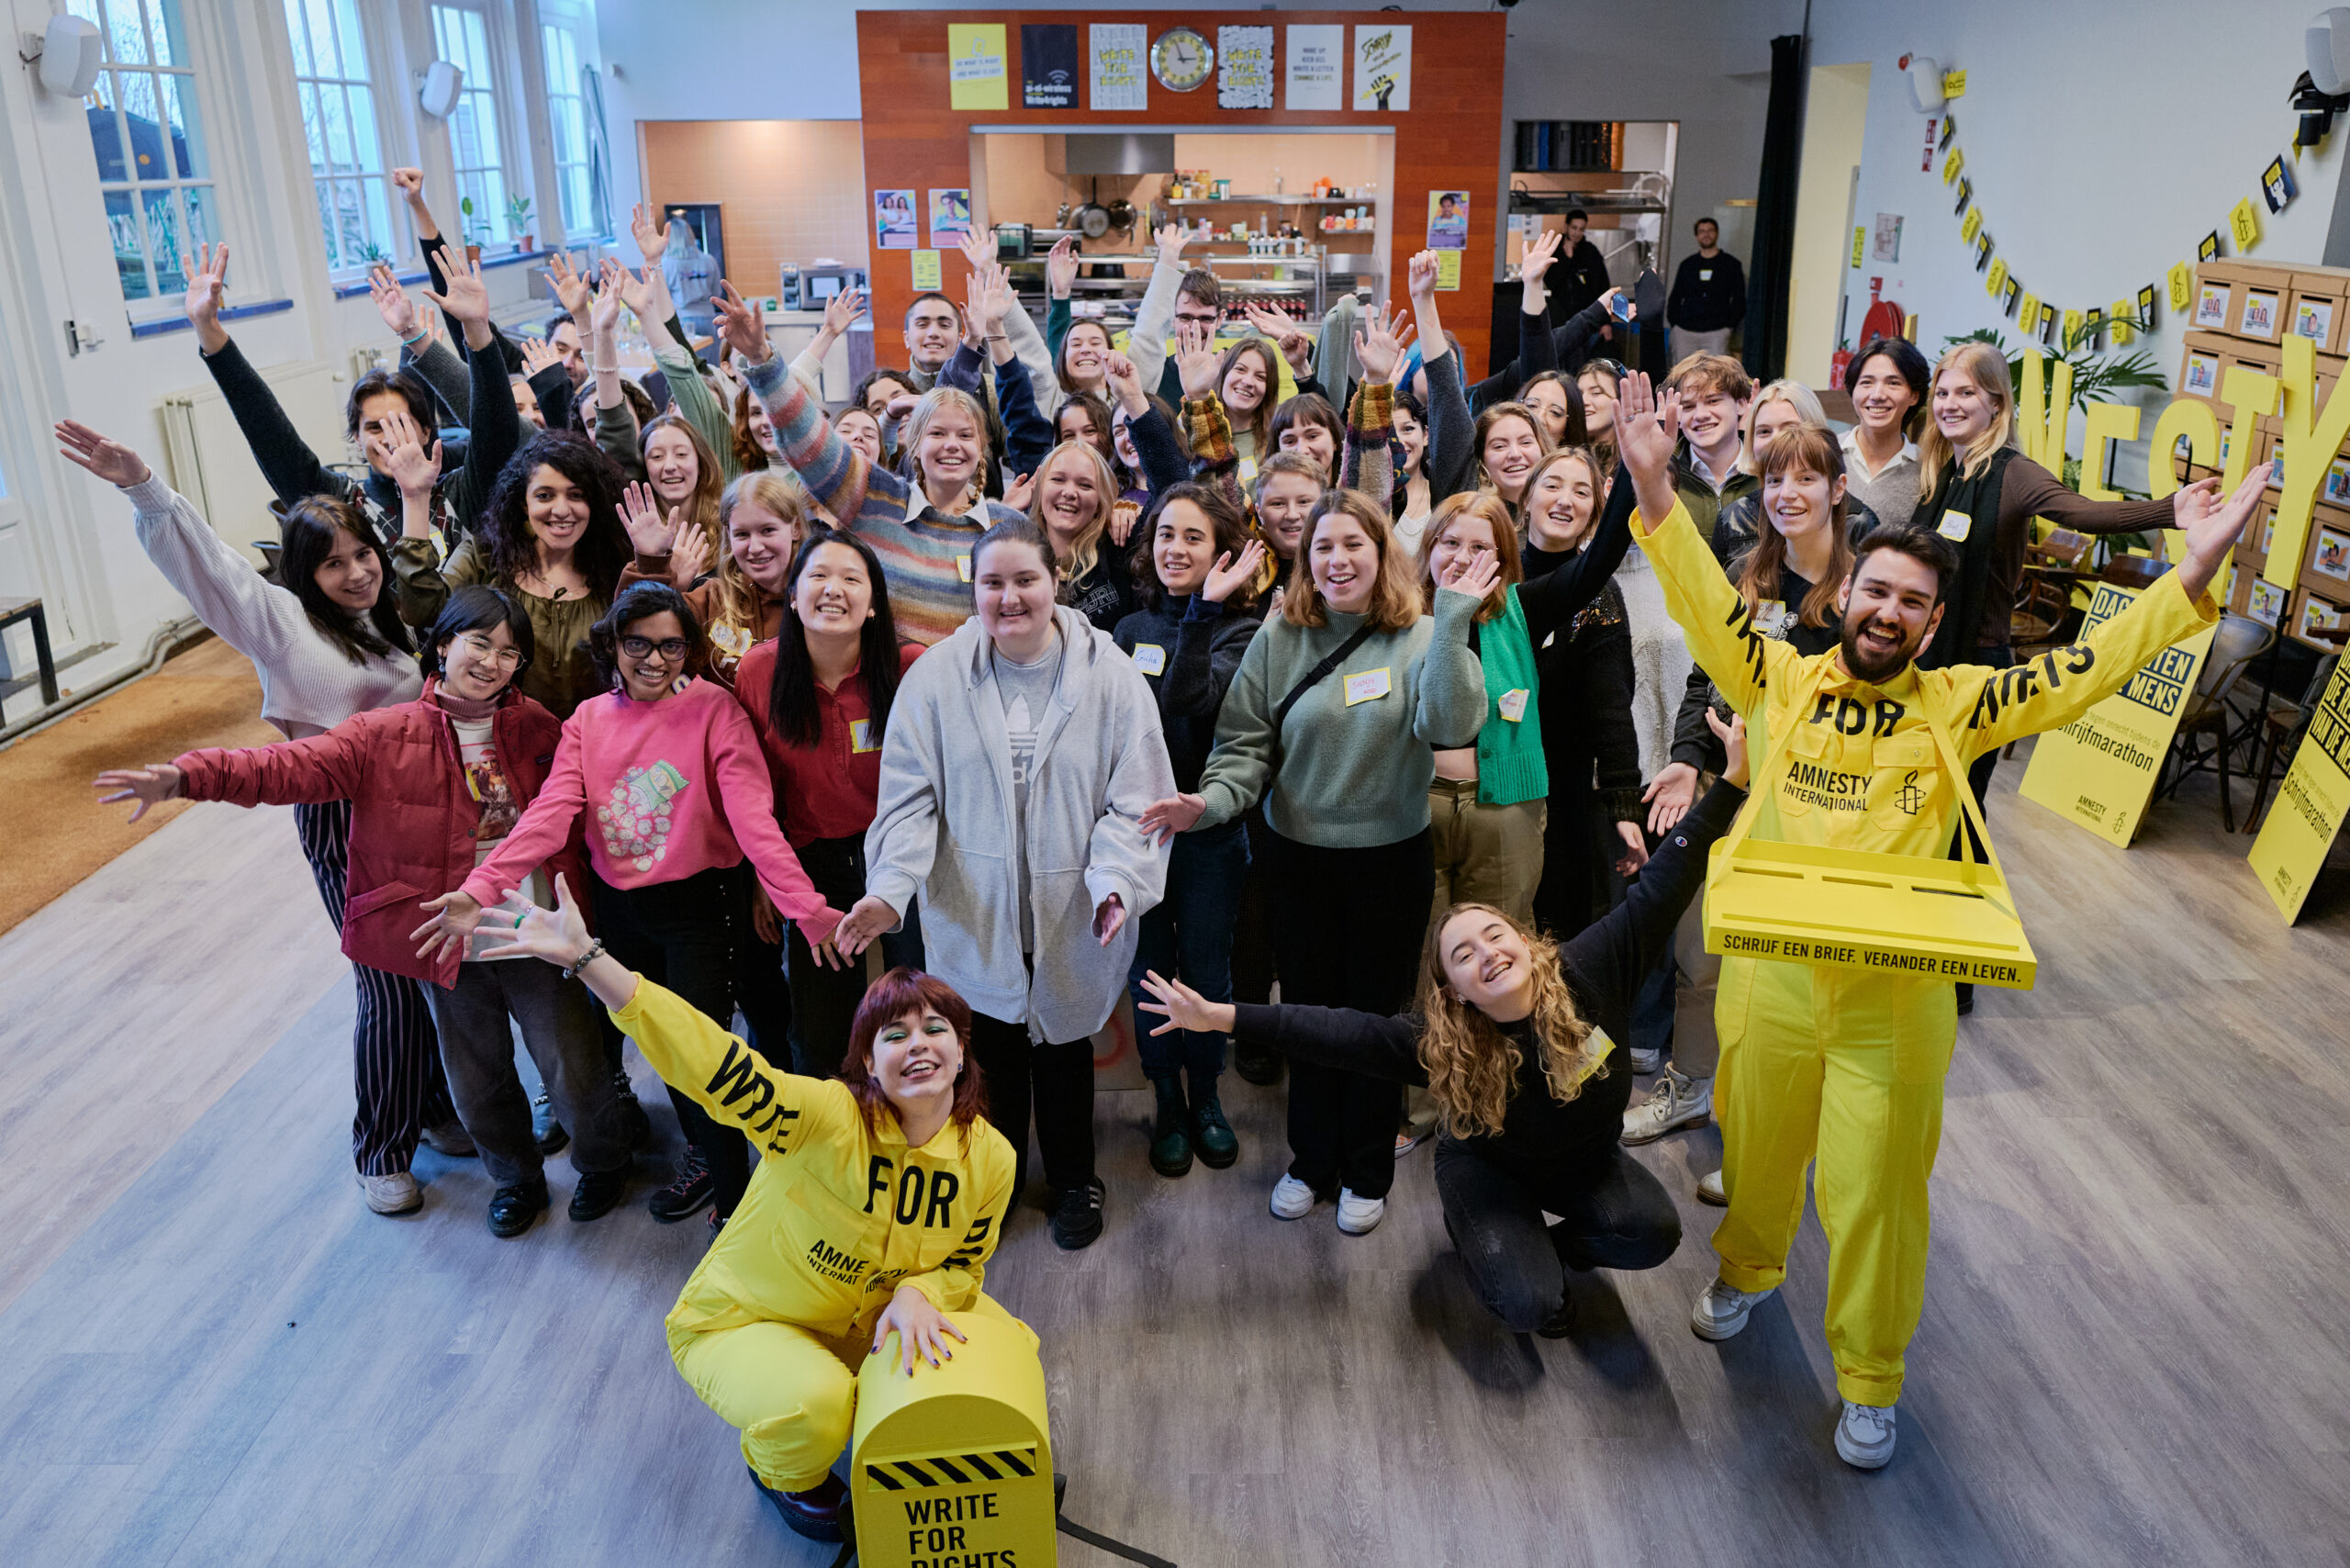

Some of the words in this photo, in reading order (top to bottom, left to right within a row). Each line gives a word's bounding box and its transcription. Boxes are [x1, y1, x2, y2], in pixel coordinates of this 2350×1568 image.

[1100, 49, 1135, 61] WRITE
[1104, 62, 1127, 73] FOR
[1226, 49, 1262, 61] WRITE
[1232, 62, 1257, 73] FOR
[2126, 673, 2179, 713] MENS
[1809, 692, 1905, 737] FOR
[2311, 706, 2333, 744] VAN
[2057, 721, 2154, 772] hrijfmarathon
[1787, 761, 1872, 796] AMNESTY
[1784, 781, 1868, 812] INTERNATIONAL
[2077, 794, 2107, 815] AMNESTY
[2284, 771, 2333, 845] Schrijfmarathon
[1724, 934, 1779, 954] SCHRIJF
[1784, 941, 1809, 958] EEN
[1814, 945, 1856, 963] BRIEF.
[1864, 950, 1937, 973] VERANDER
[1941, 959, 1968, 976] EEN
[1973, 963, 2021, 982] LEVEN.
[863, 1154, 958, 1229] FOR
[904, 1493, 1000, 1526] WRITE
[909, 1526, 967, 1555] FOR
